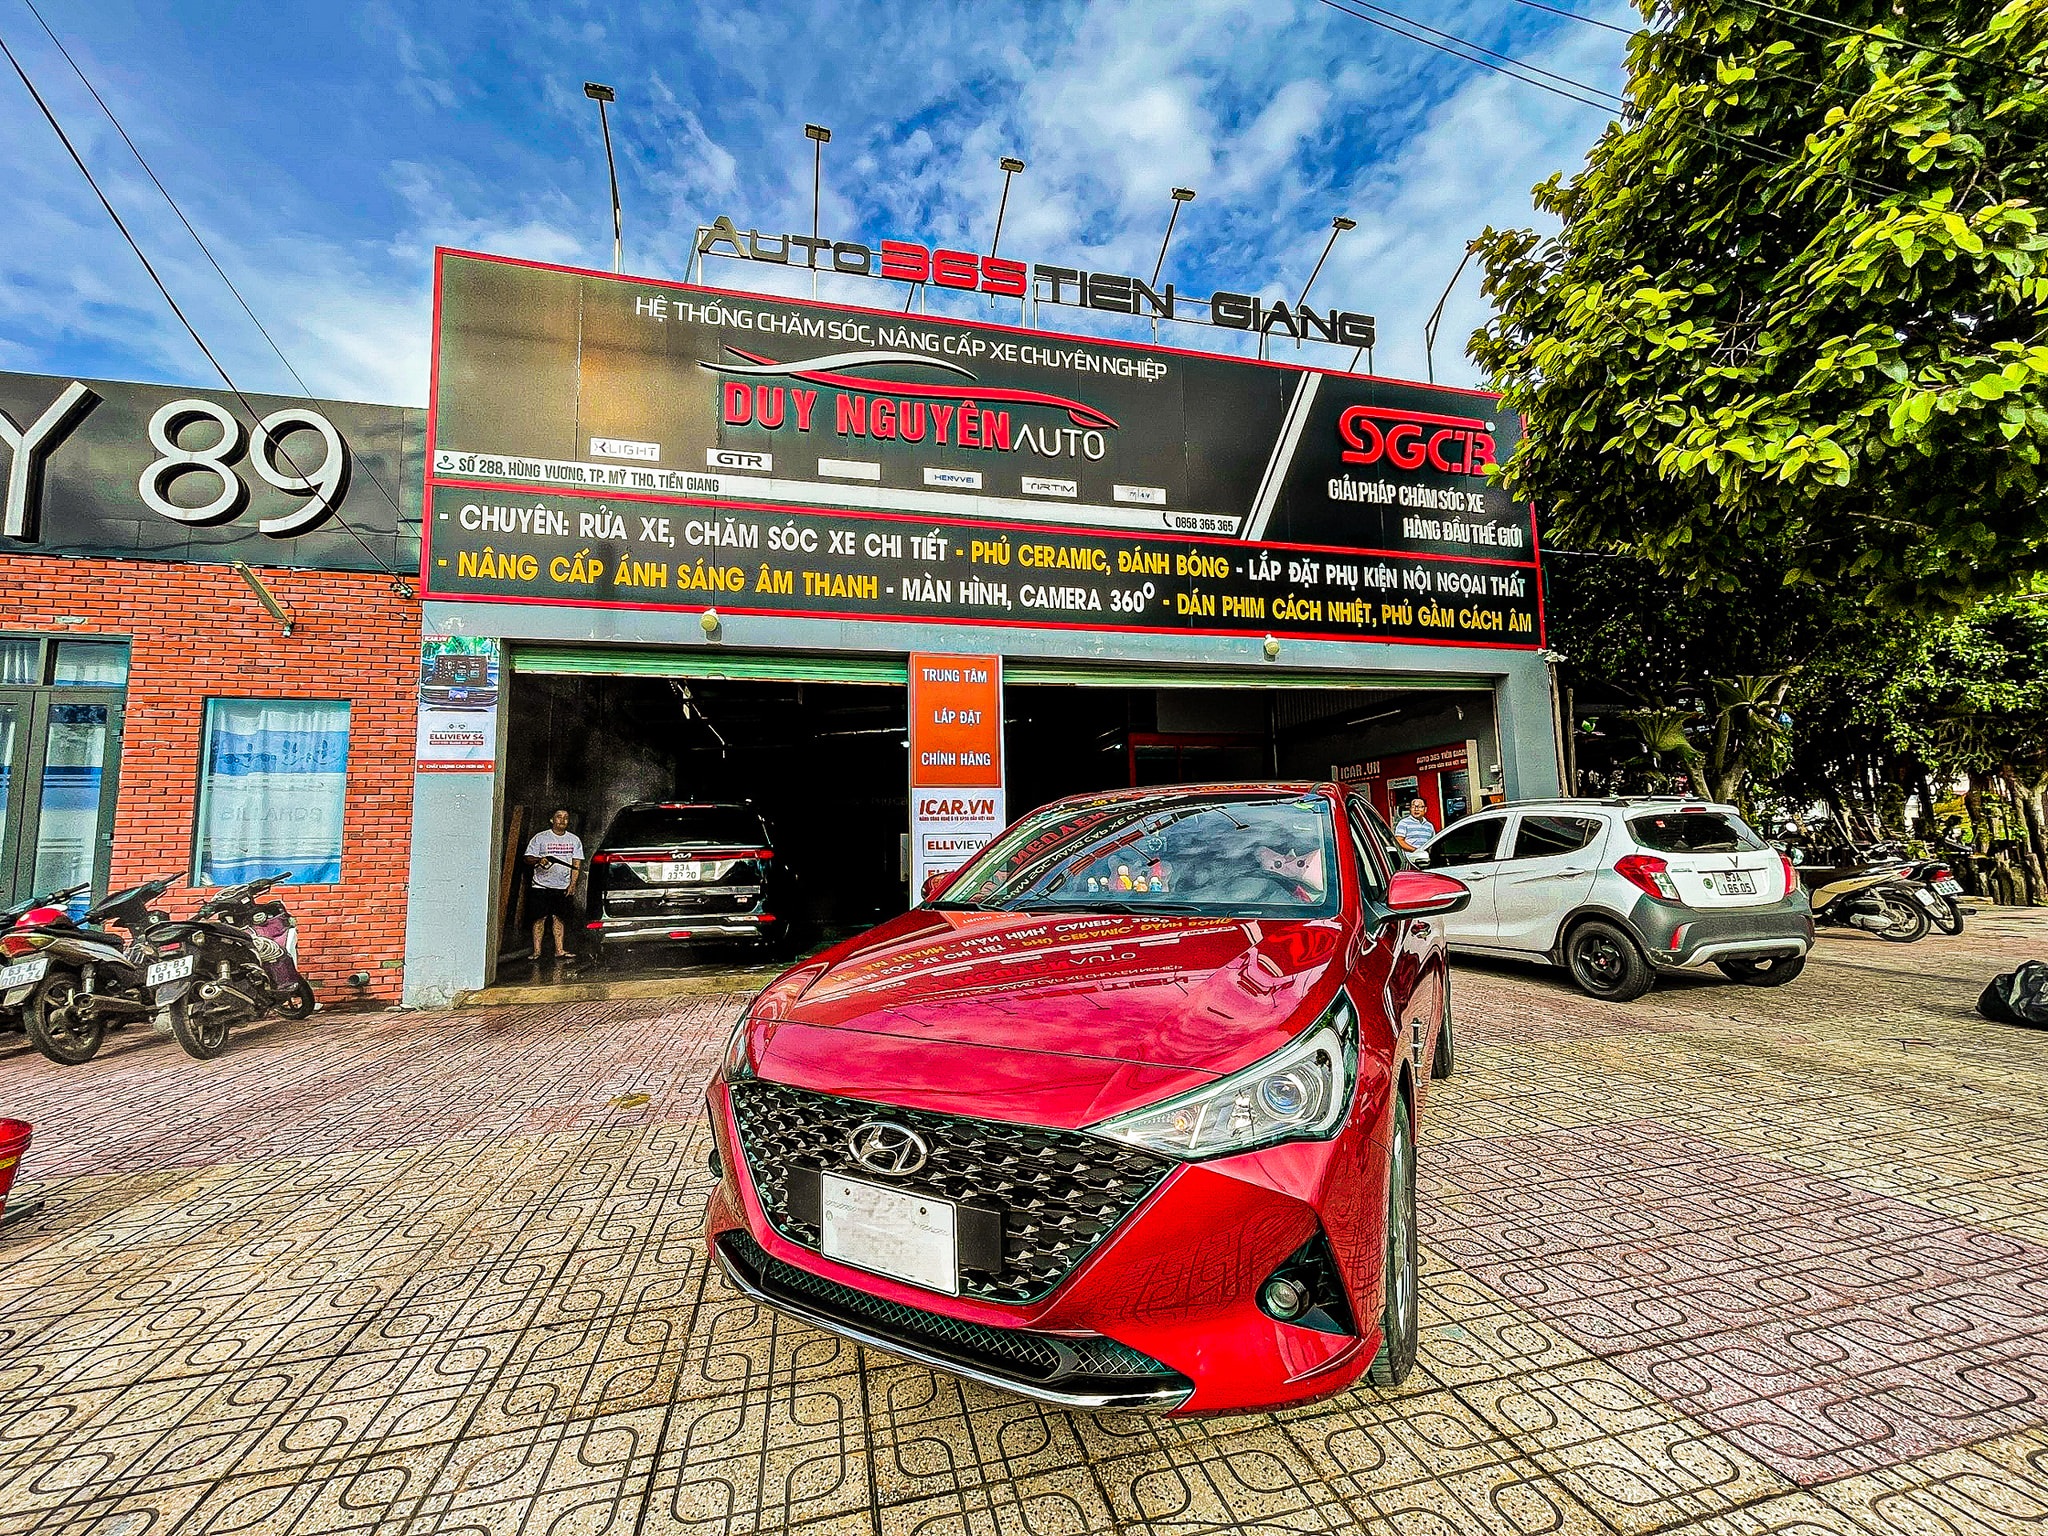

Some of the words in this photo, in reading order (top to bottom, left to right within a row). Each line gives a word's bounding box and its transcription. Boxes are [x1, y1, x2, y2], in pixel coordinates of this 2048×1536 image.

[698, 215, 871, 274] AUTO
[881, 240, 1027, 296] 365
[1034, 264, 1174, 318] TIEN
[1211, 291, 1376, 348] GIANG
[635, 295, 668, 323] HỆ
[673, 298, 753, 329] THỐNG
[757, 312, 825, 339] CHĂM
[828, 319, 875, 347] SÓC,
[879, 326, 940, 352] NÂNG
[943, 331, 986, 358] CẤP
[989, 342, 1018, 362] XE
[1021, 344, 1100, 371] CHUYÊN
[1103, 355, 1167, 383] NGHIỆP
[724, 381, 818, 432] DUY
[835, 393, 1012, 450] NGUYÊN
[1014, 423, 1106, 460] AUTO
[139, 399, 346, 536] 89
[458, 455, 477, 473] SỐ
[479, 461, 506, 477] 288,
[508, 462, 541, 478] HÙNG
[545, 465, 587, 483] VƯƠNG,
[589, 468, 606, 483] TP.
[608, 468, 627, 484] MỸ
[658, 472, 683, 490] TIỀN
[686, 477, 720, 493] GIANG
[716, 453, 763, 469] GTR
[1328, 473, 1357, 501] GIẢI
[1358, 484, 1396, 506] PHÁP
[1438, 486, 1466, 511] SÓC
[1466, 493, 1486, 514] XE
[1175, 516, 1197, 529] 0858
[1199, 518, 1216, 531] 365
[1217, 519, 1234, 532] 365
[1403, 514, 1441, 541] HÀNG
[1442, 515, 1470, 543] ĐẦU
[1469, 517, 1498, 547] THẾ
[1497, 522, 1523, 548] GIỚI
[459, 502, 570, 537] CHUYÊN:
[579, 503, 627, 540] RỬA
[639, 517, 676, 548] XE,
[684, 517, 759, 549] CHĂM
[767, 519, 818, 553] SÓC
[828, 529, 856, 556] XE
[864, 533, 902, 559] CHI
[910, 527, 948, 562] TIẾT
[971, 534, 1011, 566] PHỦ
[1017, 546, 1111, 576] CERAMIC,
[1118, 545, 1170, 575] ĐÁNH
[1176, 549, 1230, 579] BÓNG
[1249, 550, 1282, 582] LẮP
[1288, 557, 1320, 588] ĐẶT
[1326, 564, 1358, 591] PHỤ
[1364, 563, 1398, 592] KIỆN
[1403, 565, 1432, 594] NỘI
[1436, 573, 1487, 597] NGOẠI
[1490, 569, 1526, 598] THẤT
[457, 546, 540, 582] NÂNG
[549, 547, 604, 584] CẤP
[613, 552, 668, 588] ÁNH
[676, 558, 745, 592] SÁNG
[755, 562, 794, 595] ÂM
[802, 572, 879, 600] THANH
[901, 572, 951, 603] MÀN
[959, 575, 1012, 611] HÌNH,
[1018, 584, 1102, 612] CAMERA
[1177, 587, 1215, 617] DÁN
[1222, 596, 1266, 620] PHIM
[1272, 593, 1323, 622] CÁCH
[1328, 597, 1377, 628] NHIỆT,
[1381, 598, 1413, 626] PHỦ
[1417, 598, 1456, 629] GẦM
[1458, 605, 1503, 632] CÁCH
[1508, 607, 1533, 633] ÂM
[922, 668, 960, 683] TRUNG
[963, 668, 988, 683] TÂM
[933, 707, 956, 724] LẮP
[959, 709, 982, 726] ĐẶT
[921, 750, 956, 766] CHÍNH
[919, 799, 995, 815] ICAR.VN
[928, 840, 988, 850] ELLIVIEW
